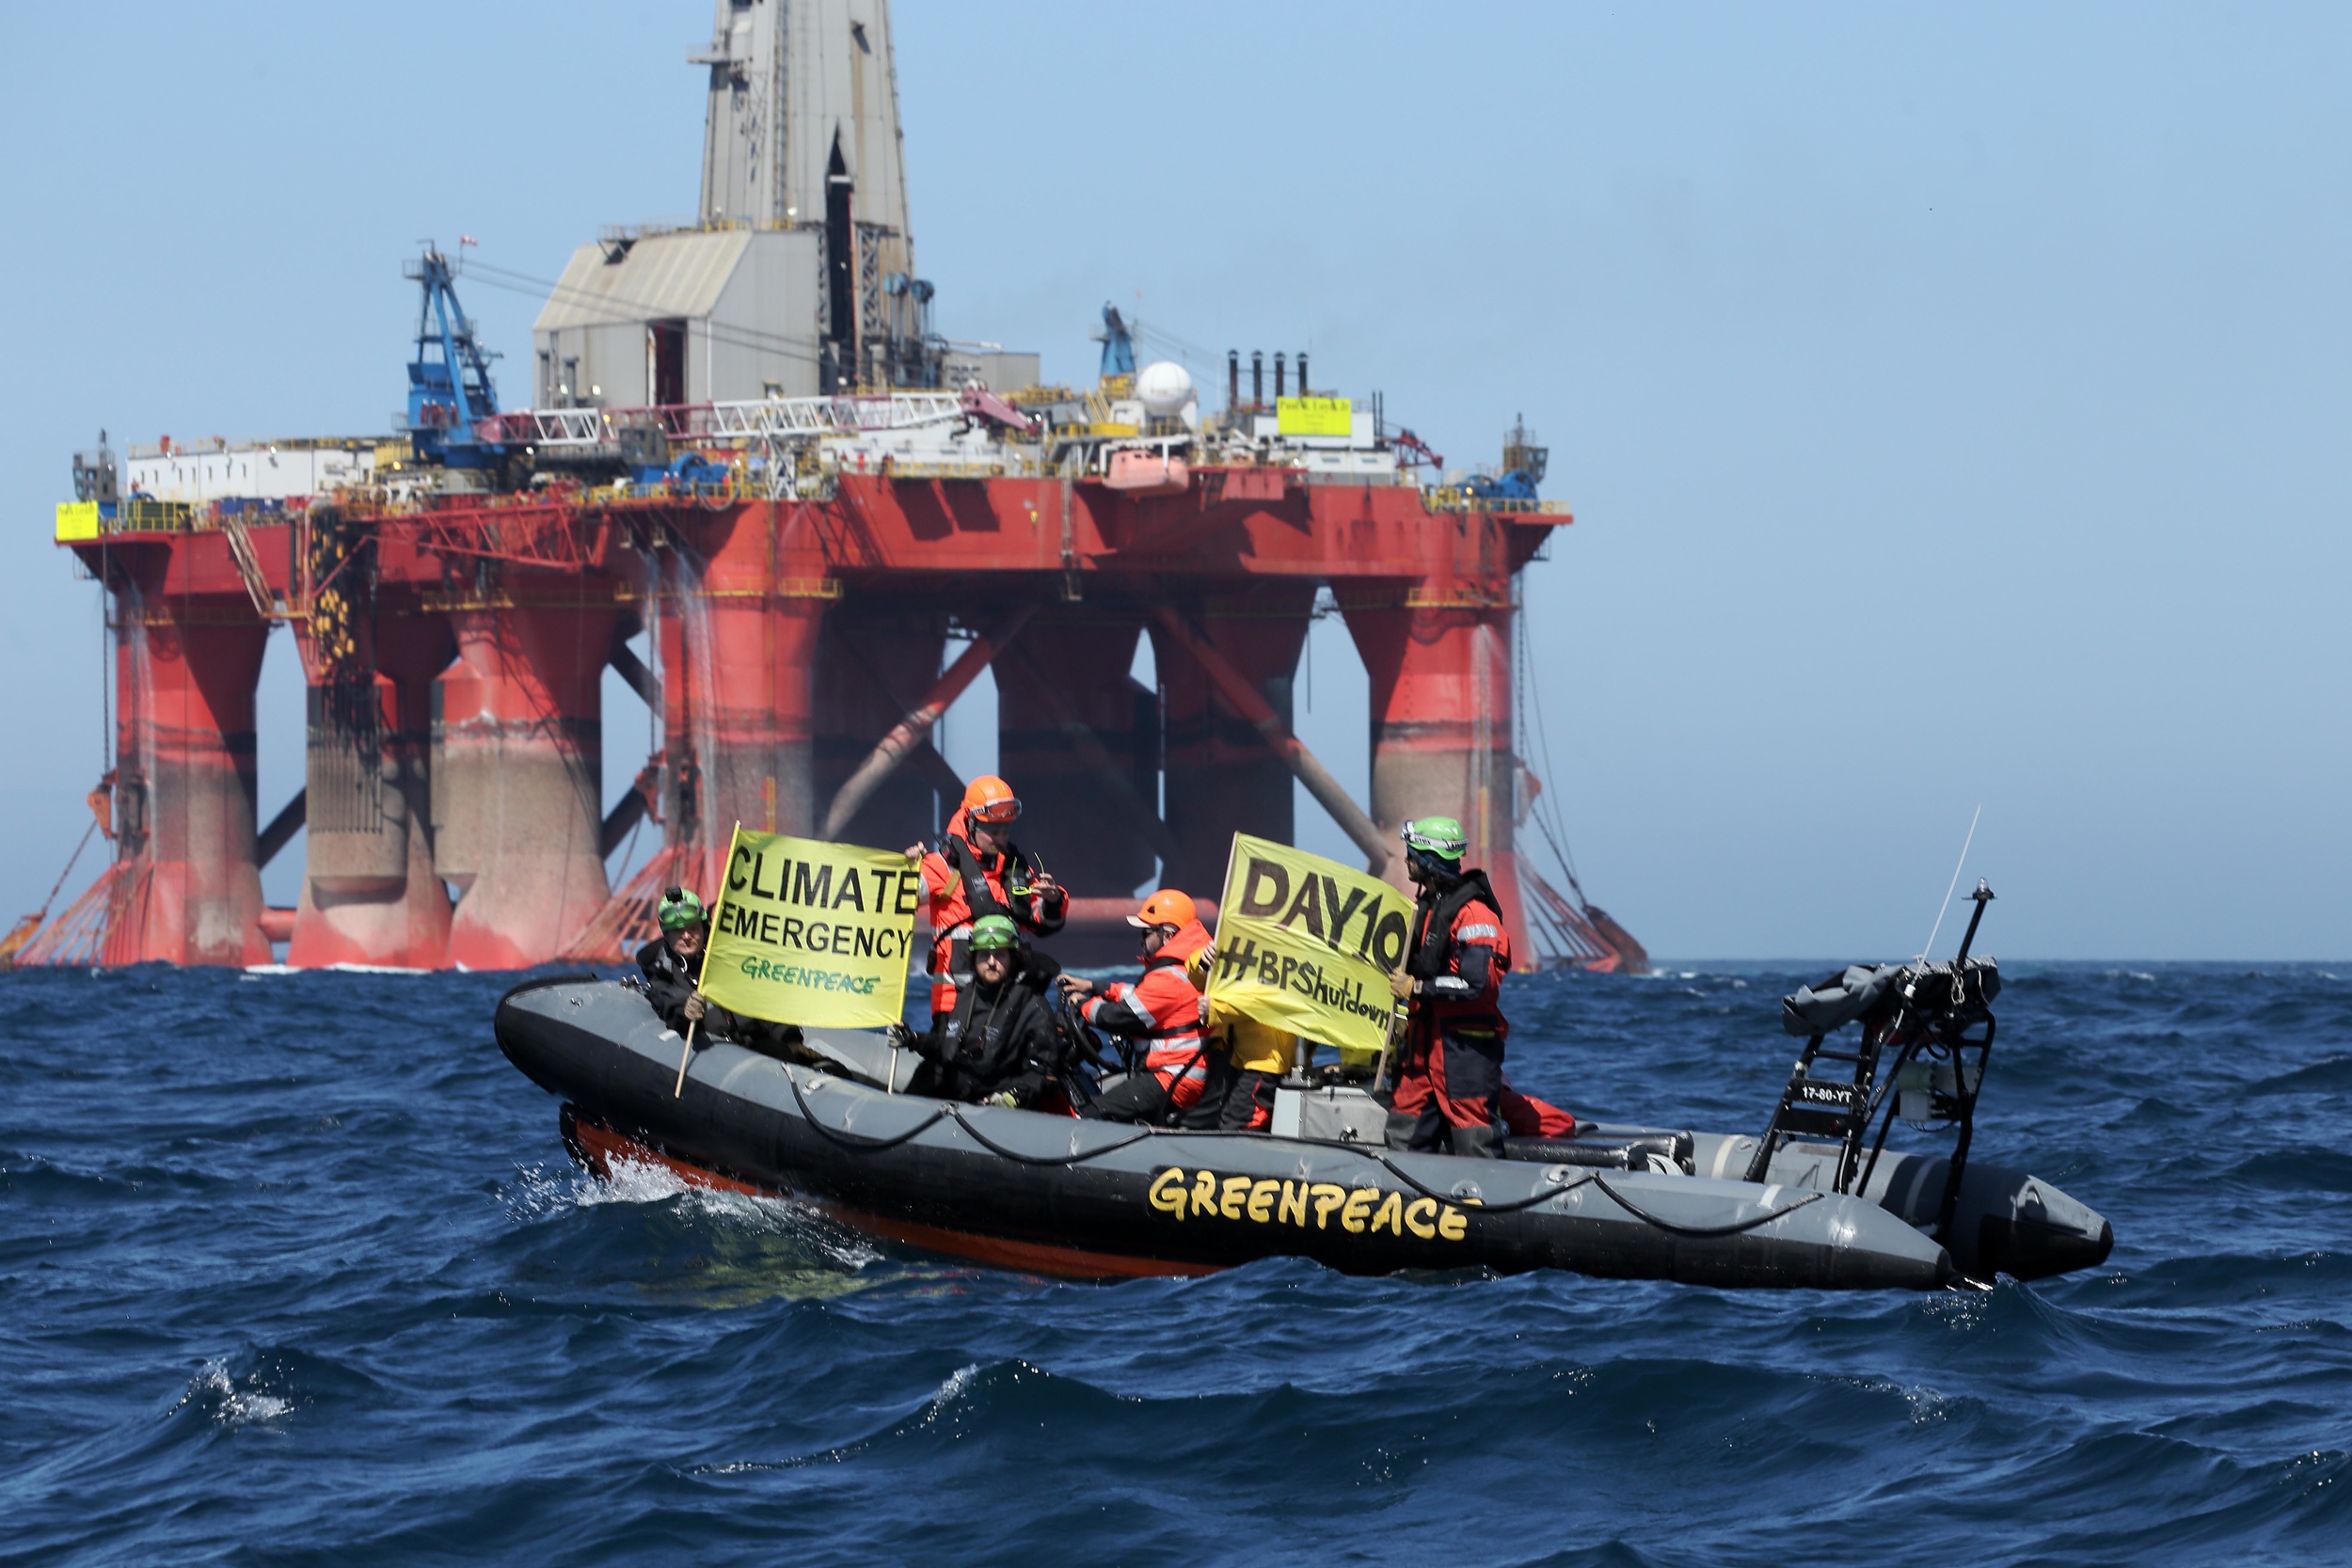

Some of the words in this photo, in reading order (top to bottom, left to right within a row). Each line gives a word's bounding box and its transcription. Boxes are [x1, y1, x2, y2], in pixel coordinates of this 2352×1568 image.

[728, 846, 920, 915] CLIMATE
[718, 901, 914, 959] EMERGENCY
[740, 956, 881, 994] GREENPEACE
[1217, 935, 1391, 1031] #BPShutdown
[1148, 1166, 1484, 1241] GREENPEACE
